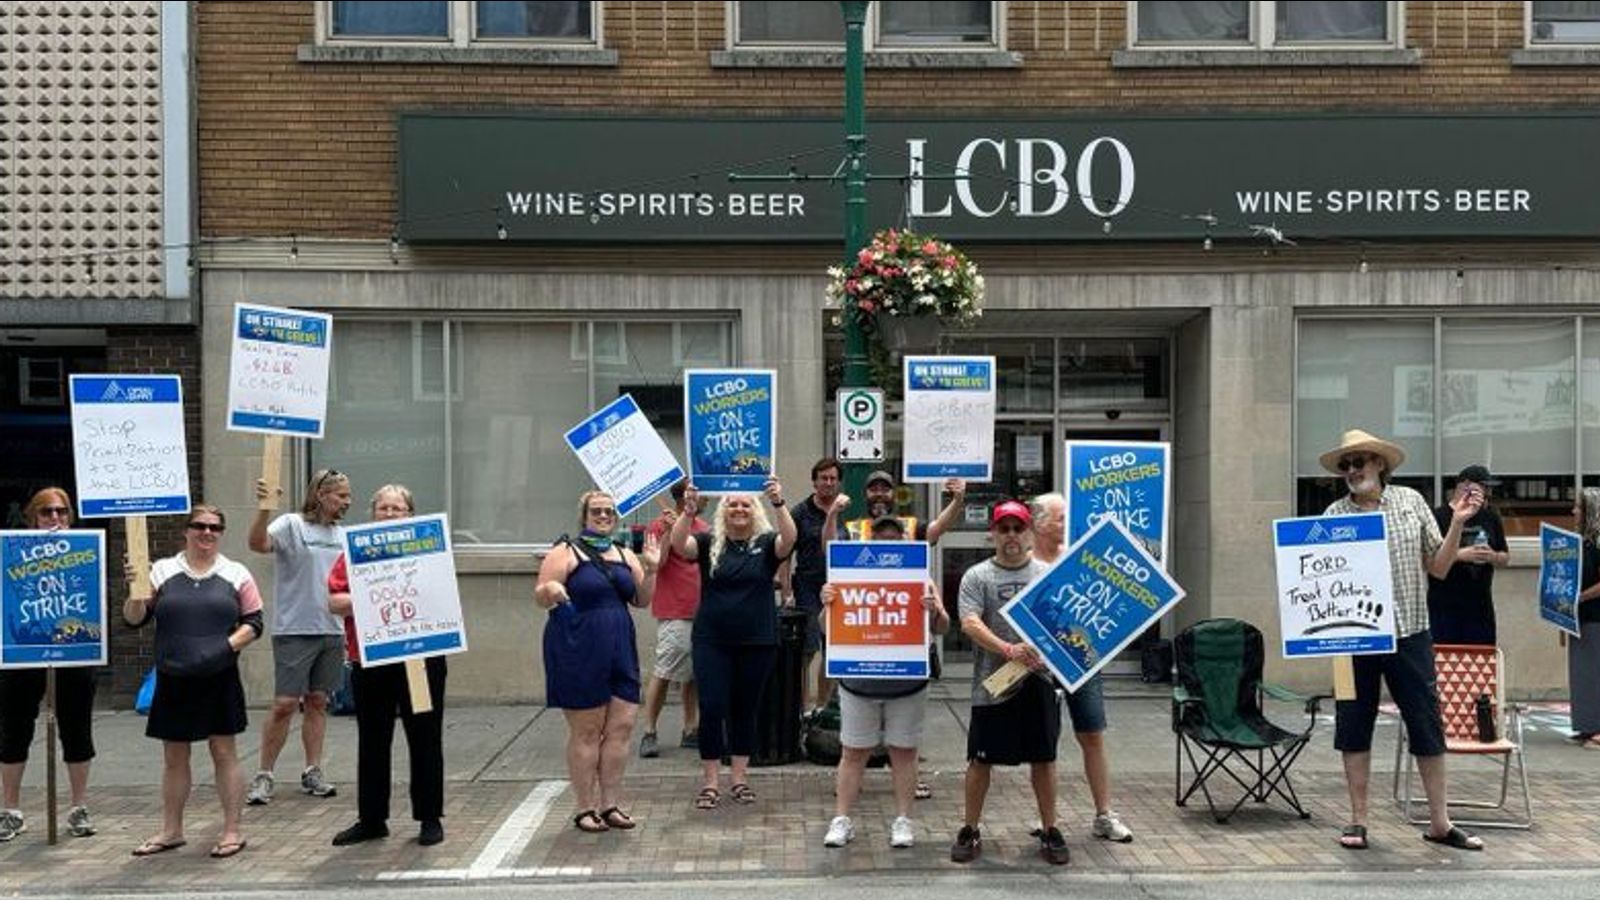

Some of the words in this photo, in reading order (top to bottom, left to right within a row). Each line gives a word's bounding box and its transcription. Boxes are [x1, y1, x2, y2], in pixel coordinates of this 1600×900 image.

[906, 136, 1136, 218] LCBO
[704, 377, 748, 399] LCBO
[719, 407, 743, 431] ON
[854, 400, 869, 418] P
[703, 427, 761, 455] STRIKE
[848, 429, 855, 441] 2
[858, 429, 874, 441] HR
[1089, 451, 1137, 473] LCBO
[1076, 462, 1161, 492] WORKERS
[1104, 486, 1131, 509] ON
[20, 539, 71, 562] LCBO
[7, 549, 97, 580] WORKERS
[1102, 545, 1151, 583] LCBO
[1299, 553, 1348, 576] FORD
[38, 571, 67, 596] ON
[1080, 550, 1161, 609] WORKERS
[840, 586, 911, 605] We're
[1085, 580, 1120, 609] ON
[20, 592, 88, 623] STRIKE
[842, 607, 872, 626] all
[878, 605, 908, 626] in!
[1052, 583, 1118, 640] STRIKE
